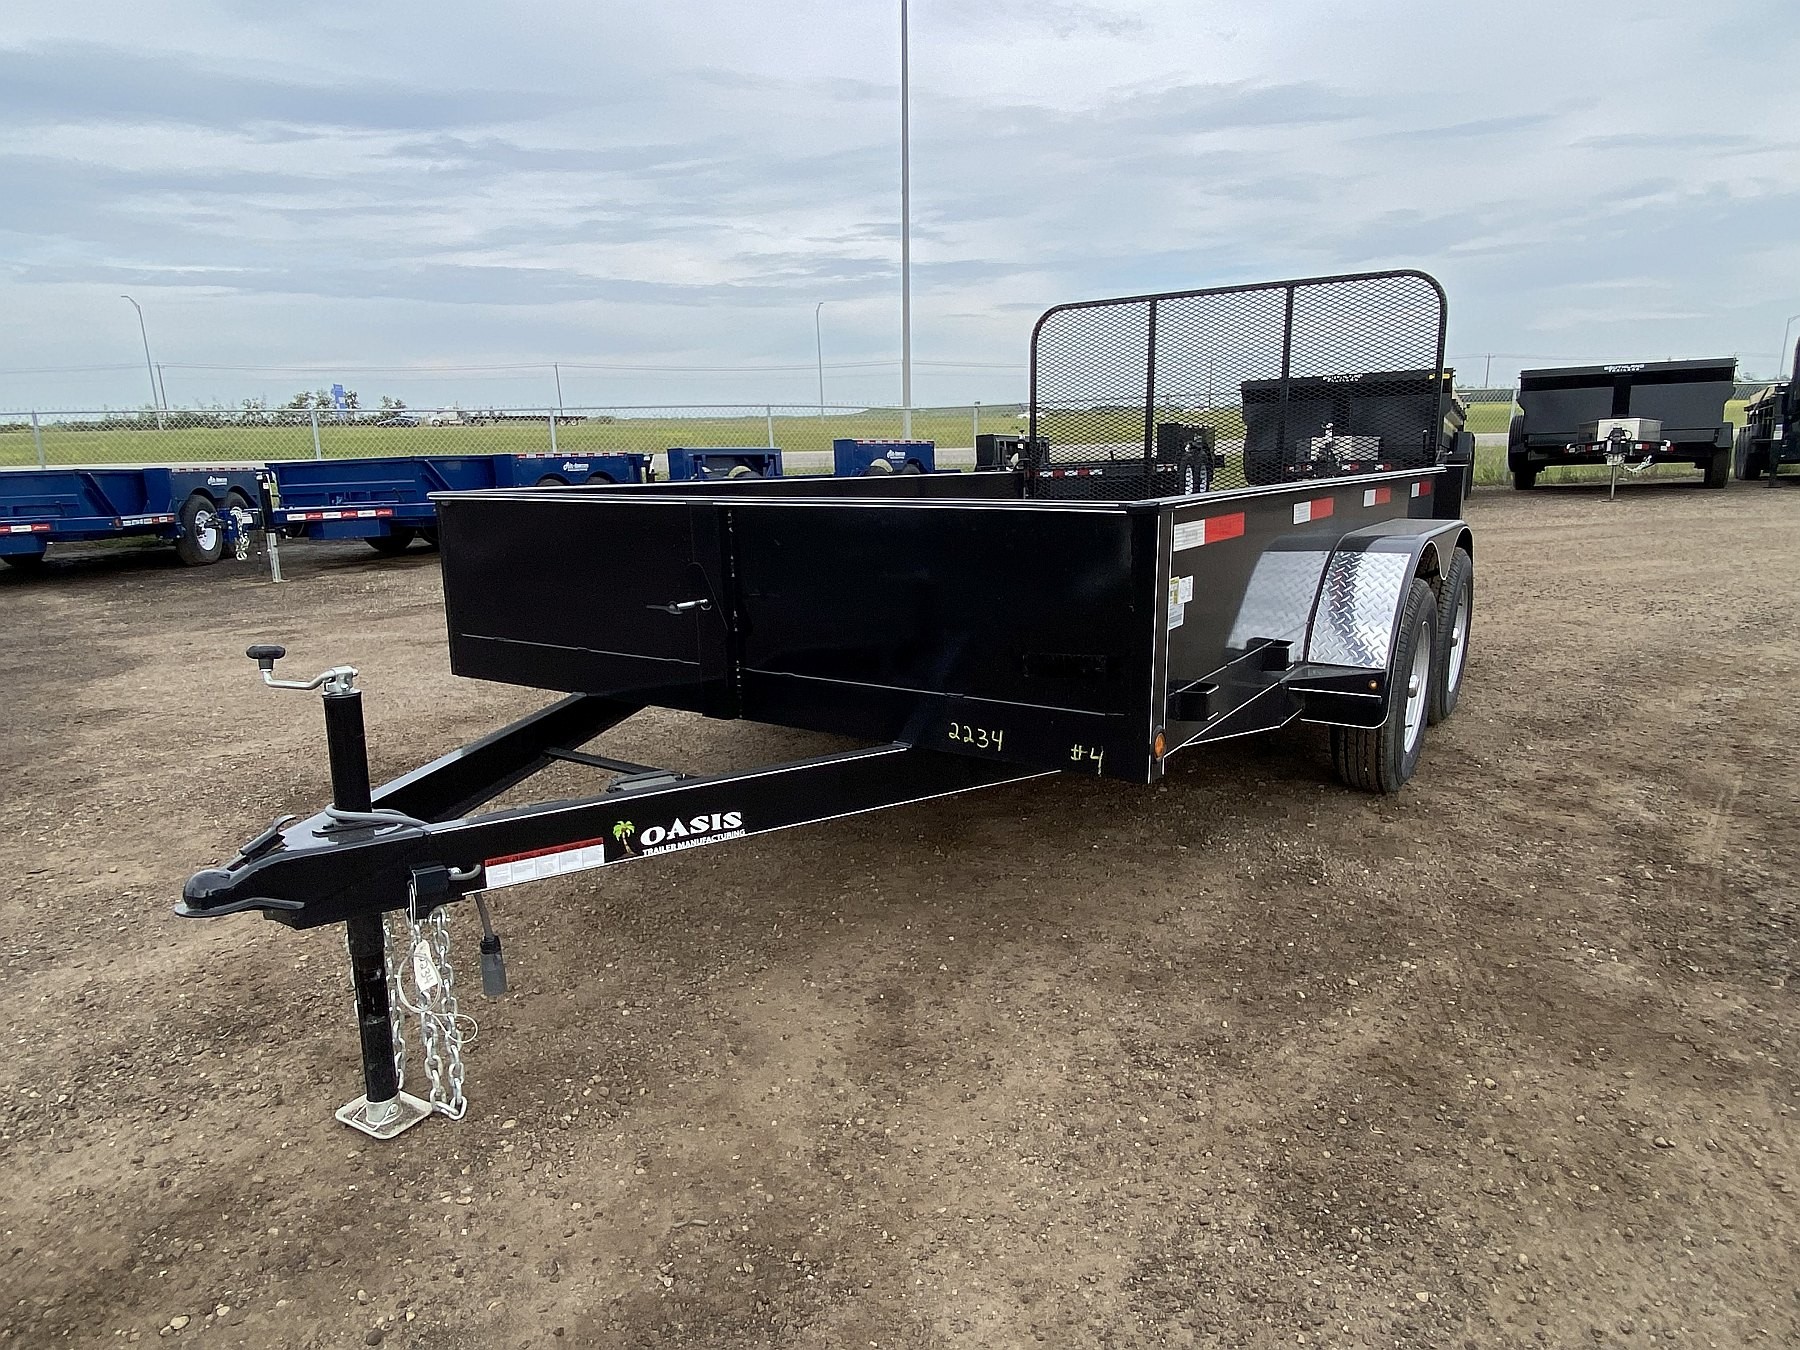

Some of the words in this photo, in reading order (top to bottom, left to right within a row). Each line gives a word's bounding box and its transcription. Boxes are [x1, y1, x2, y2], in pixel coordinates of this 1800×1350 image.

[948, 722, 1004, 752] 2234
[1070, 743, 1105, 777] #4
[640, 811, 743, 846] OASIS
[642, 843, 677, 857] TRAILER
[677, 828, 746, 850] MANUFACTURING
